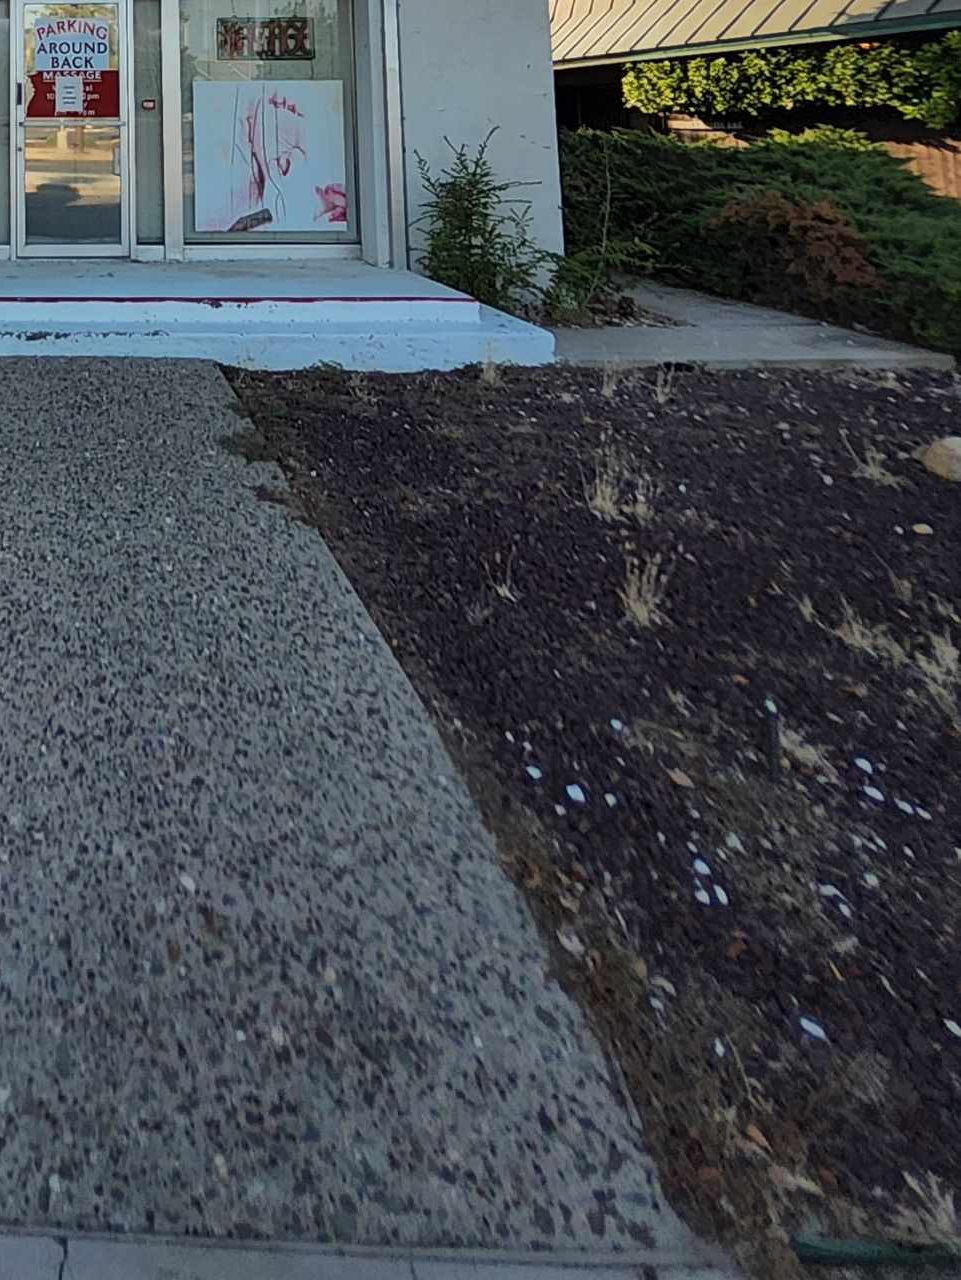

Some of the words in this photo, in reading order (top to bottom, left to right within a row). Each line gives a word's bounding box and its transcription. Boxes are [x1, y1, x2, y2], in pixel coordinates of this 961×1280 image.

[36, 19, 108, 40] PARKING
[36, 42, 108, 54] AROUND
[51, 56, 94, 68] BACK
[43, 71, 102, 80] MASSAGE
